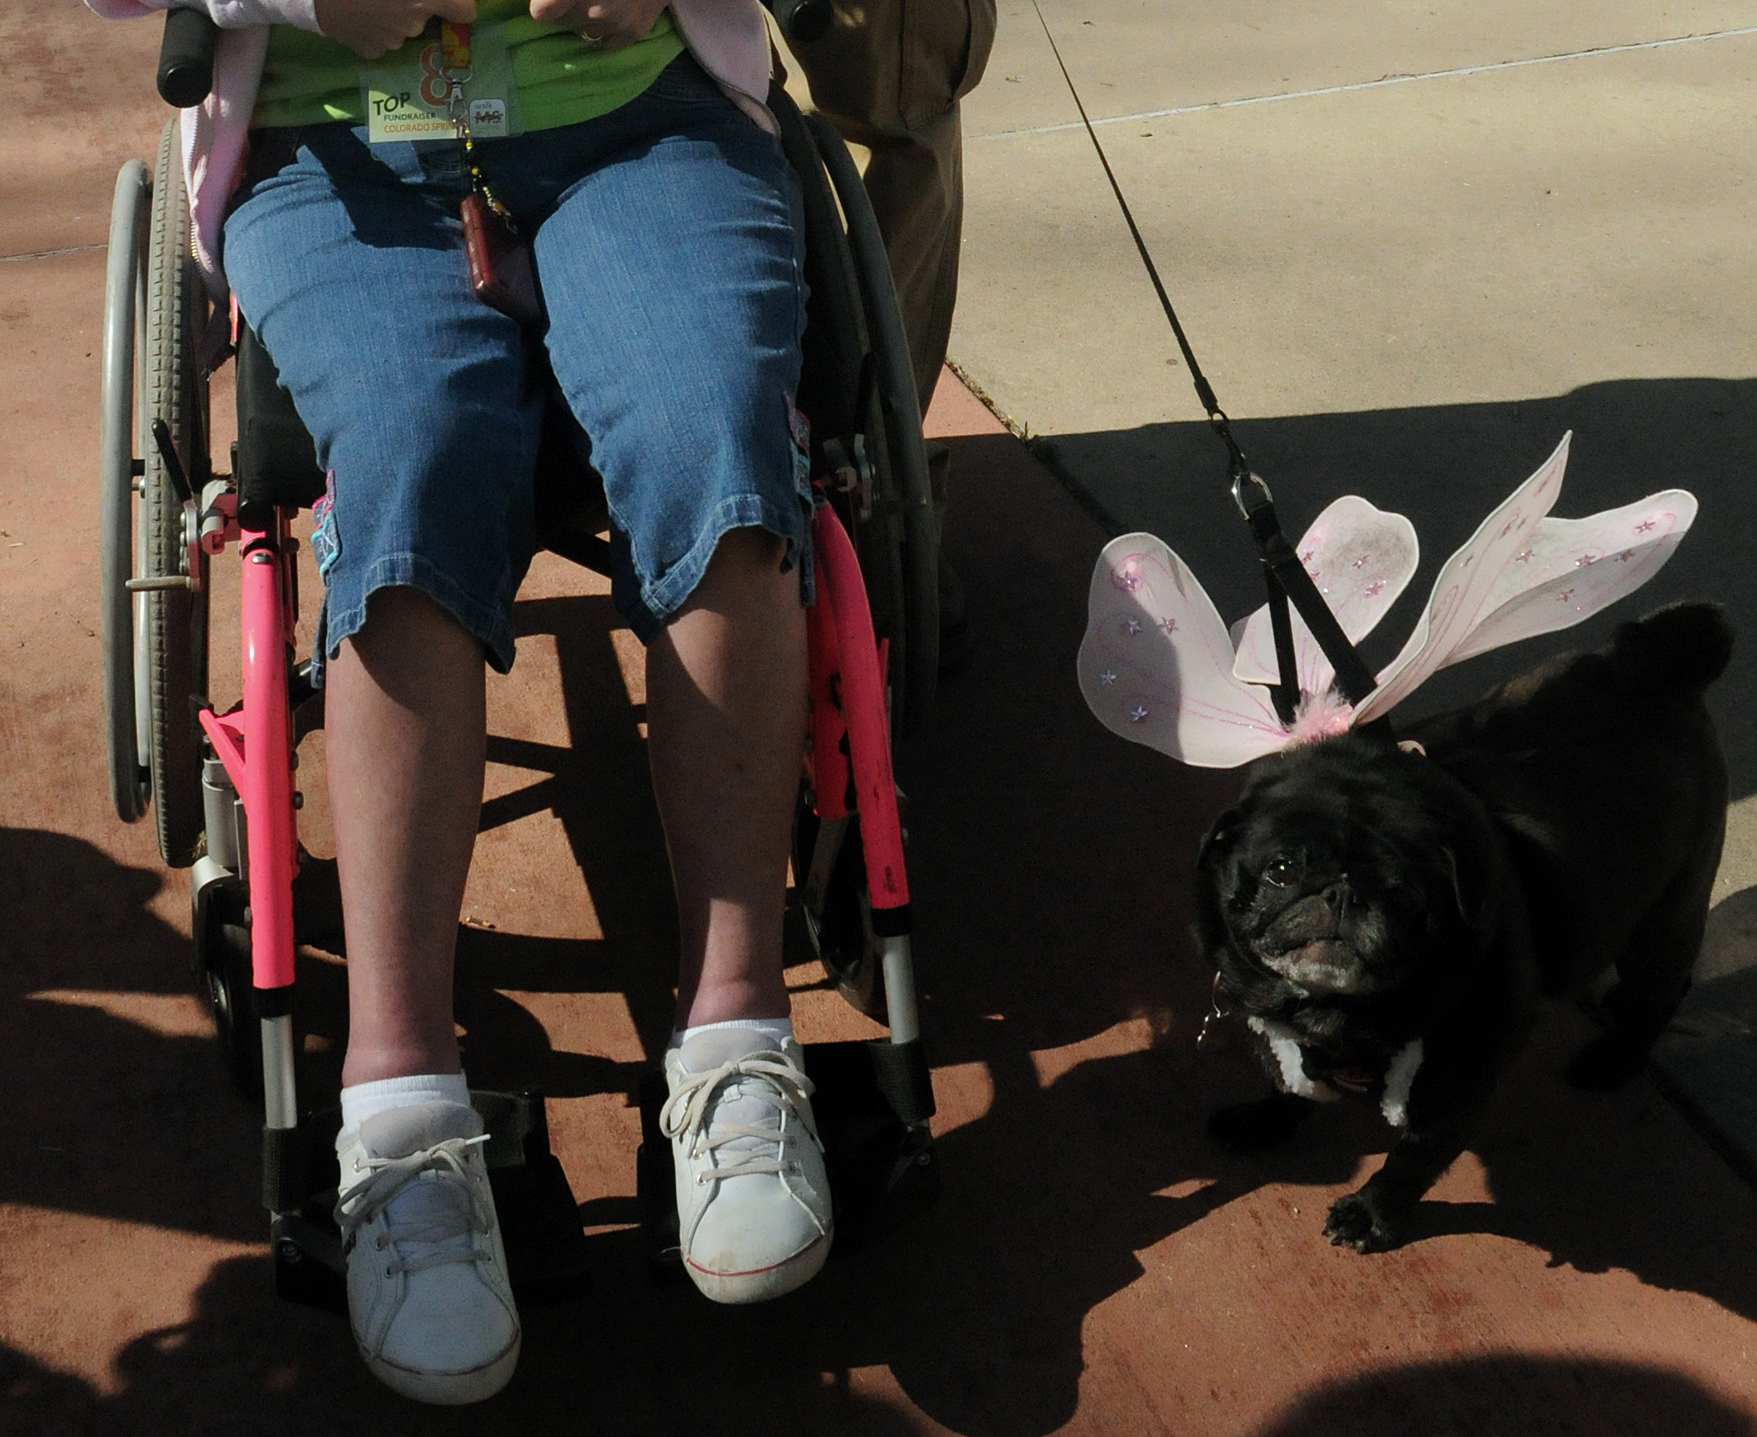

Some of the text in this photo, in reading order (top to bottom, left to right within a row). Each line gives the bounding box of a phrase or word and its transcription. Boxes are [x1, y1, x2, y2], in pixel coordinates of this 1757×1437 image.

[373, 92, 411, 116] TOP
[384, 112, 436, 122] FUNDRAISER
[384, 121, 456, 133] COLORADO SPRIN
